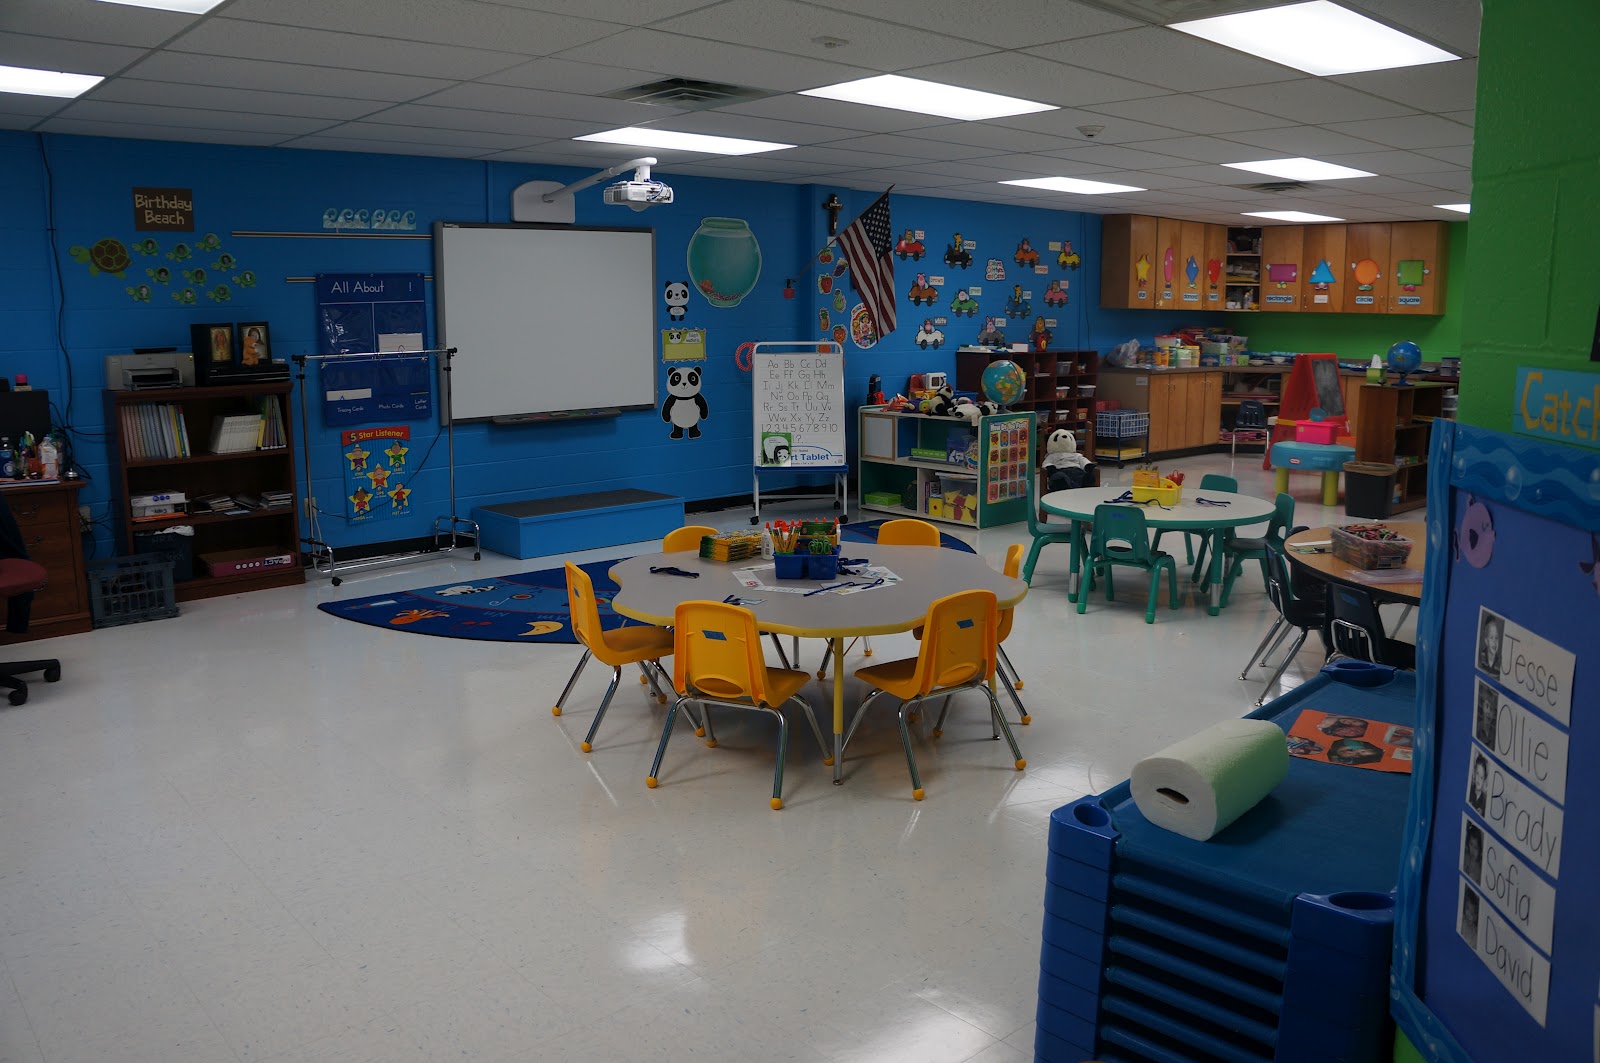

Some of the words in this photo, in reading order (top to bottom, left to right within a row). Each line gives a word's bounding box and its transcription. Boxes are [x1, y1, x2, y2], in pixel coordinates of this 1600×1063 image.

[135, 194, 192, 211] Birthday
[144, 210, 184, 224] Beach
[331, 282, 349, 293] All
[353, 280, 384, 293] About
[768, 360, 778, 368] Aa
[784, 360, 794, 368] Bb
[800, 360, 810, 368] Cc
[816, 359, 826, 368] Dd
[770, 370, 779, 379] Ee
[784, 370, 793, 379] Ff
[798, 370, 810, 381] Gg
[814, 370, 825, 378] Hh
[350, 433, 357, 441] 5
[1500, 634, 1558, 706] Jesse
[1498, 705, 1548, 781] Ollie
[1490, 770, 1557, 870] Brady
[1486, 847, 1531, 926] Sofia
[1485, 916, 1534, 1003] David
